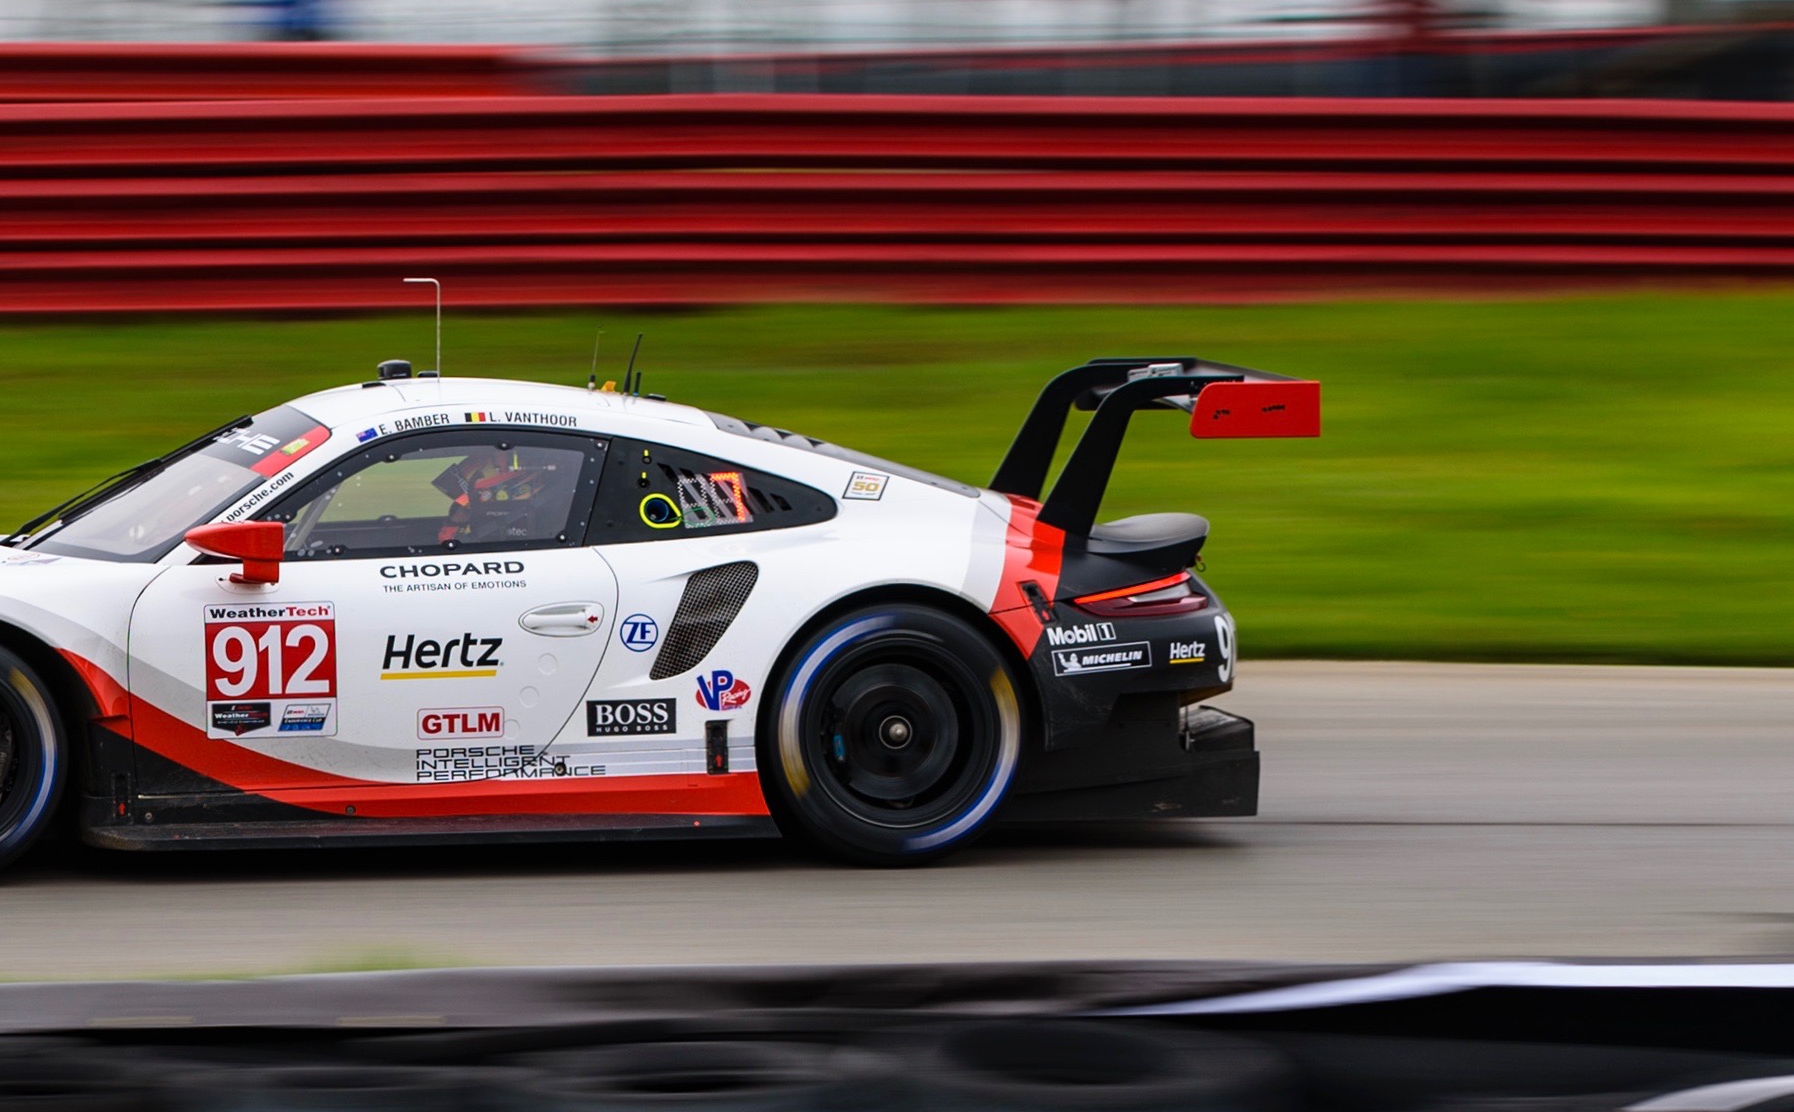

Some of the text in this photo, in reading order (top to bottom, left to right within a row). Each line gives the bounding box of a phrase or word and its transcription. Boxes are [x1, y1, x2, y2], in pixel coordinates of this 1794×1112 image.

[378, 413, 450, 436] E. BAMBER
[489, 412, 577, 427] L. VANTHOOR
[379, 561, 525, 579] CHOPARD
[383, 579, 527, 593] THE ARTISAN OF EMOTIONS
[209, 606, 330, 619] WeatherTech
[1046, 623, 1098, 646] Mobil
[382, 632, 503, 670] Hertz
[1082, 650, 1143, 666] MICHELIN
[1169, 641, 1206, 659] Hertz
[212, 623, 330, 697] 912
[696, 670, 734, 711] VP
[595, 702, 669, 726] BOSS
[422, 712, 500, 735] GTLM
[596, 724, 668, 733] HUGO BOSS
[416, 745, 535, 759] PORSCHE
[416, 755, 571, 770] INTELLIGENT
